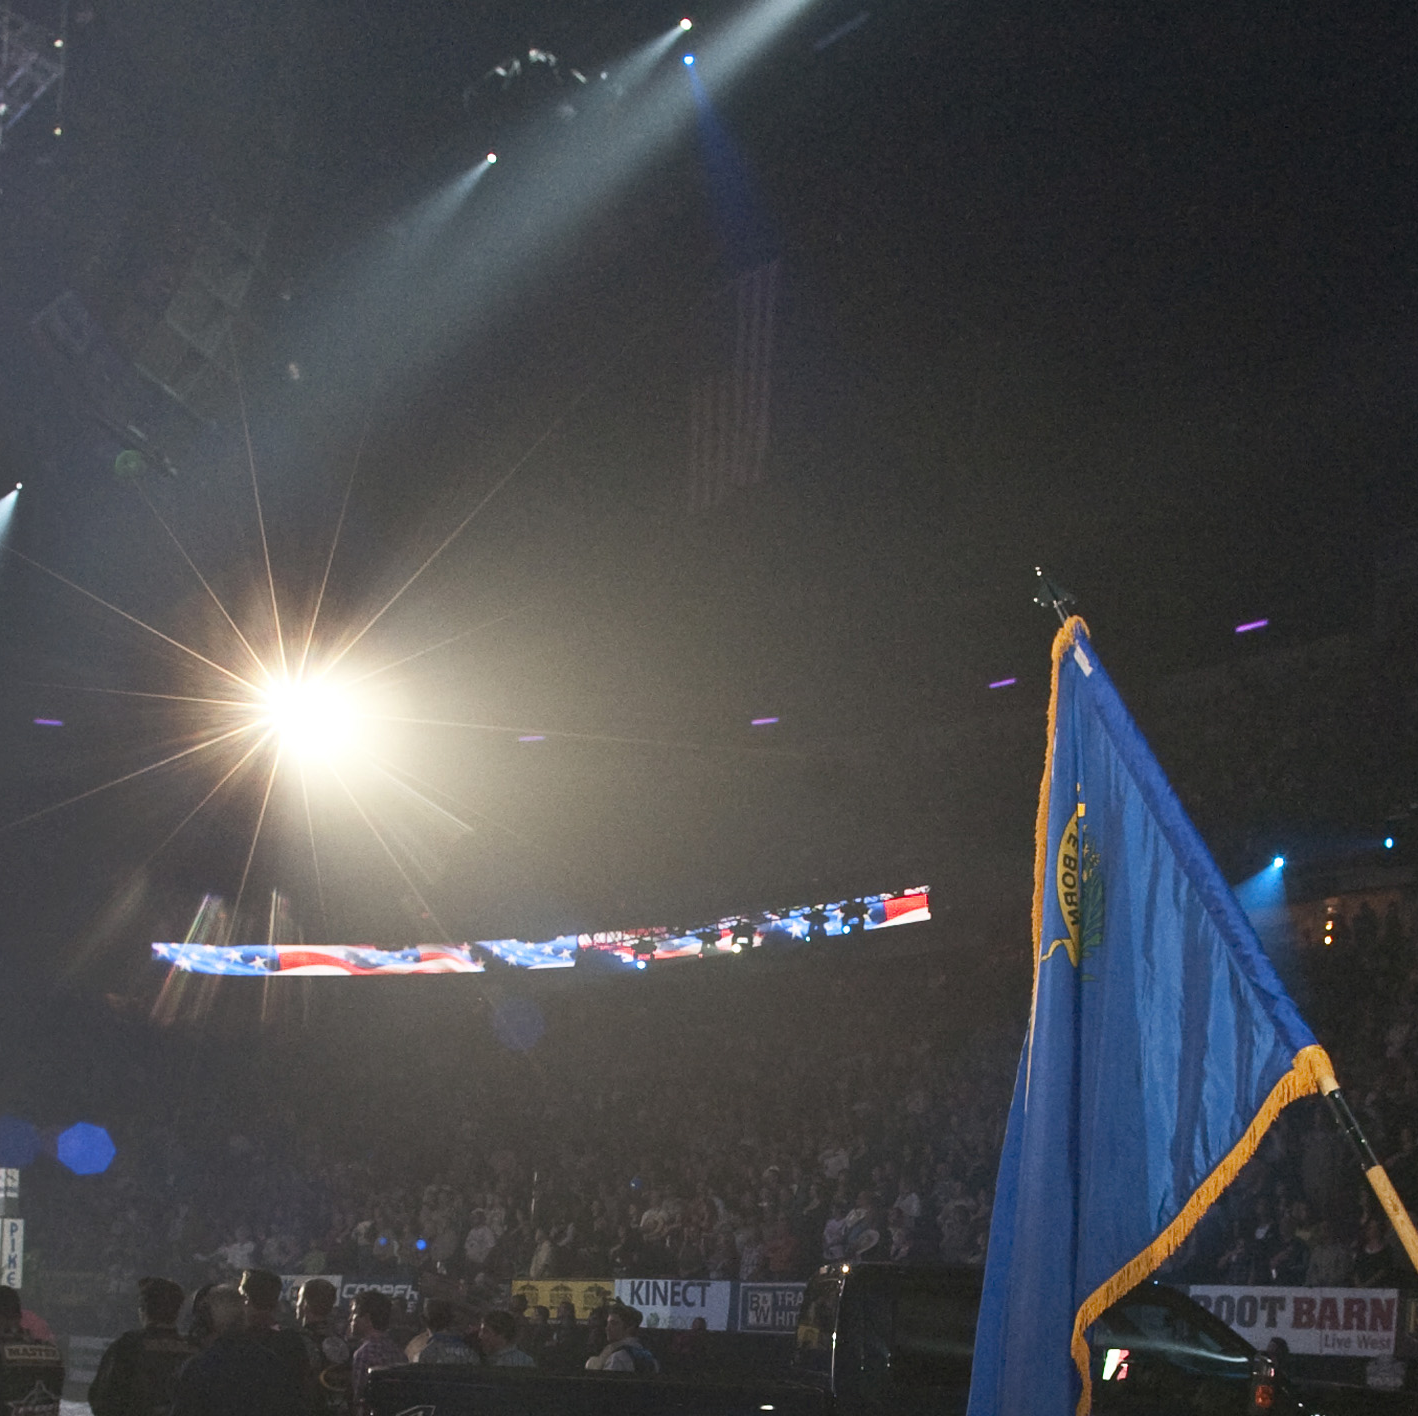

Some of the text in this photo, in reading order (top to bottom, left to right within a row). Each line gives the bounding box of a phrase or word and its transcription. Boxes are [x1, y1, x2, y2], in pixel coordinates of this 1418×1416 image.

[630, 1280, 711, 1308] KINECT
[1292, 1296, 1396, 1332] BARN
[1324, 1335, 1392, 1350] Live West
